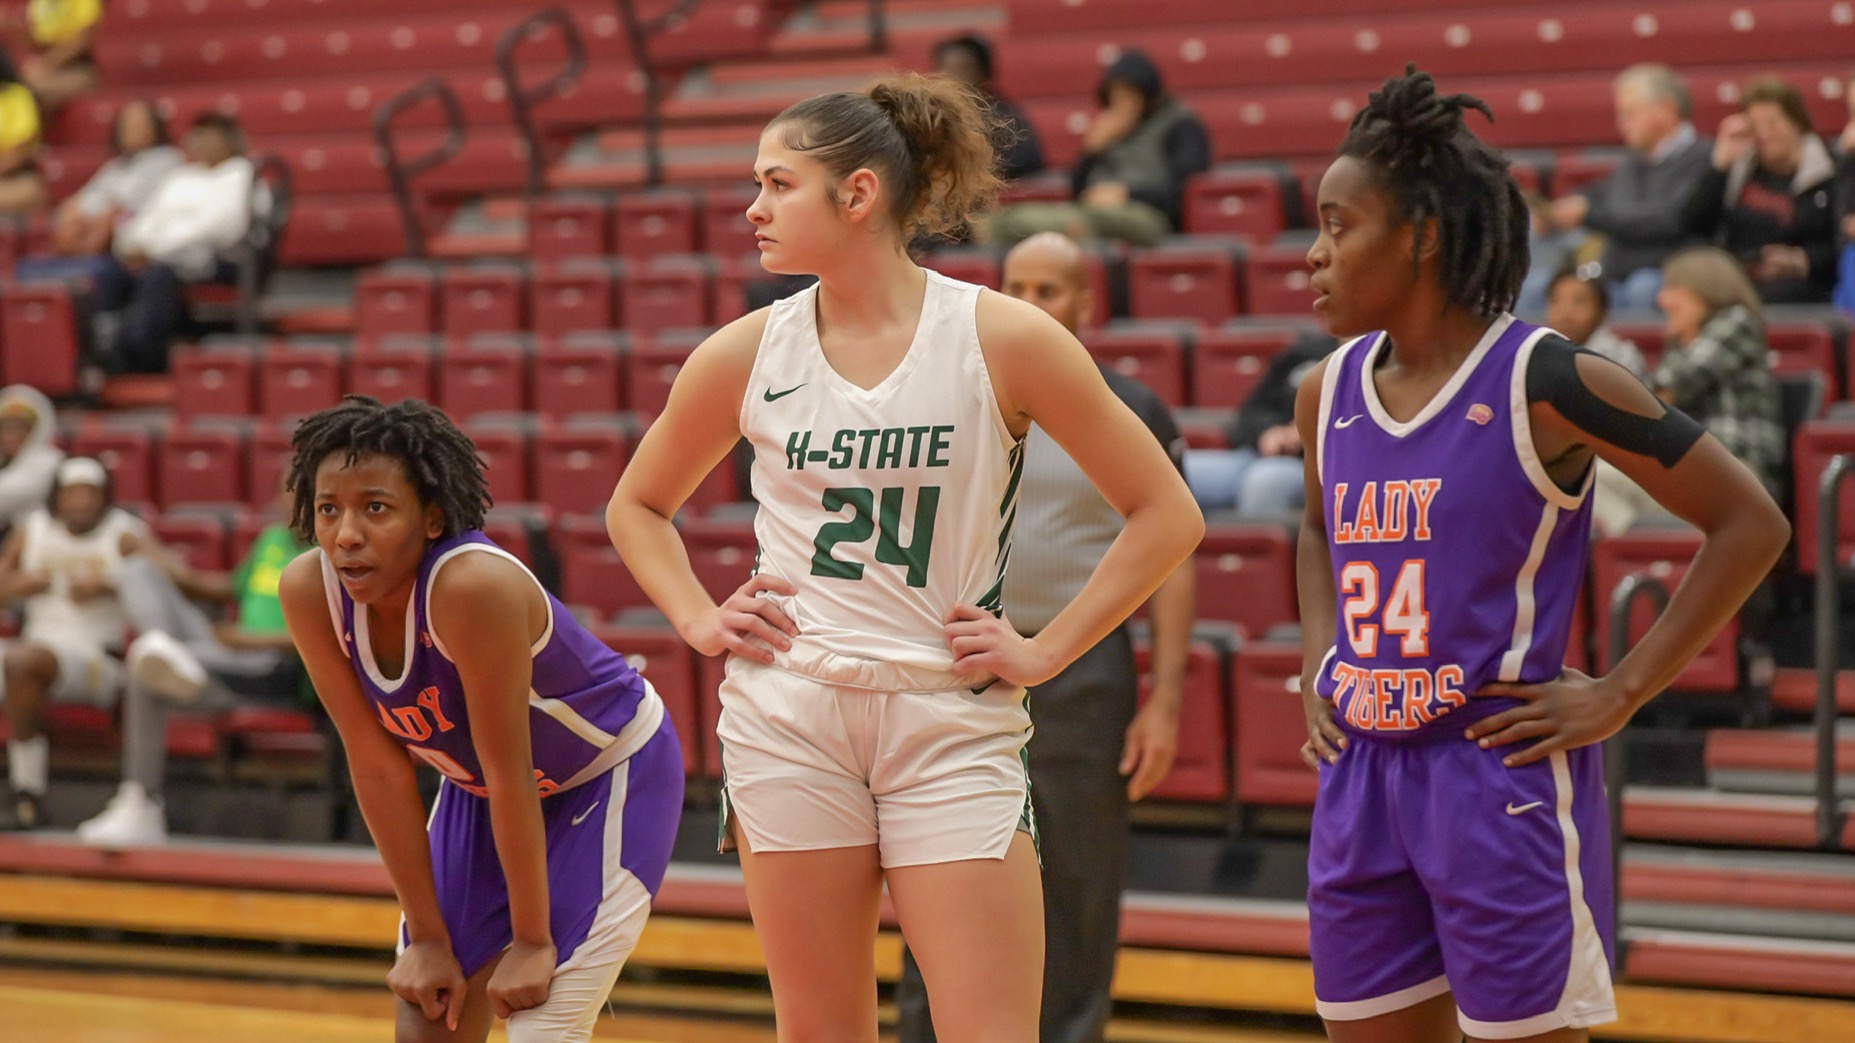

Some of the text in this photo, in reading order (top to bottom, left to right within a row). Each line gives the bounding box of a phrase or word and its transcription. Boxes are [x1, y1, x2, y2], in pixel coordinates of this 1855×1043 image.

[787, 426, 954, 470] K-STATE
[810, 486, 940, 588] 24
[1334, 479, 1442, 543] LADY
[1341, 559, 1430, 658] 24
[377, 686, 455, 742] ADY
[1332, 661, 1467, 730] TIGERS
